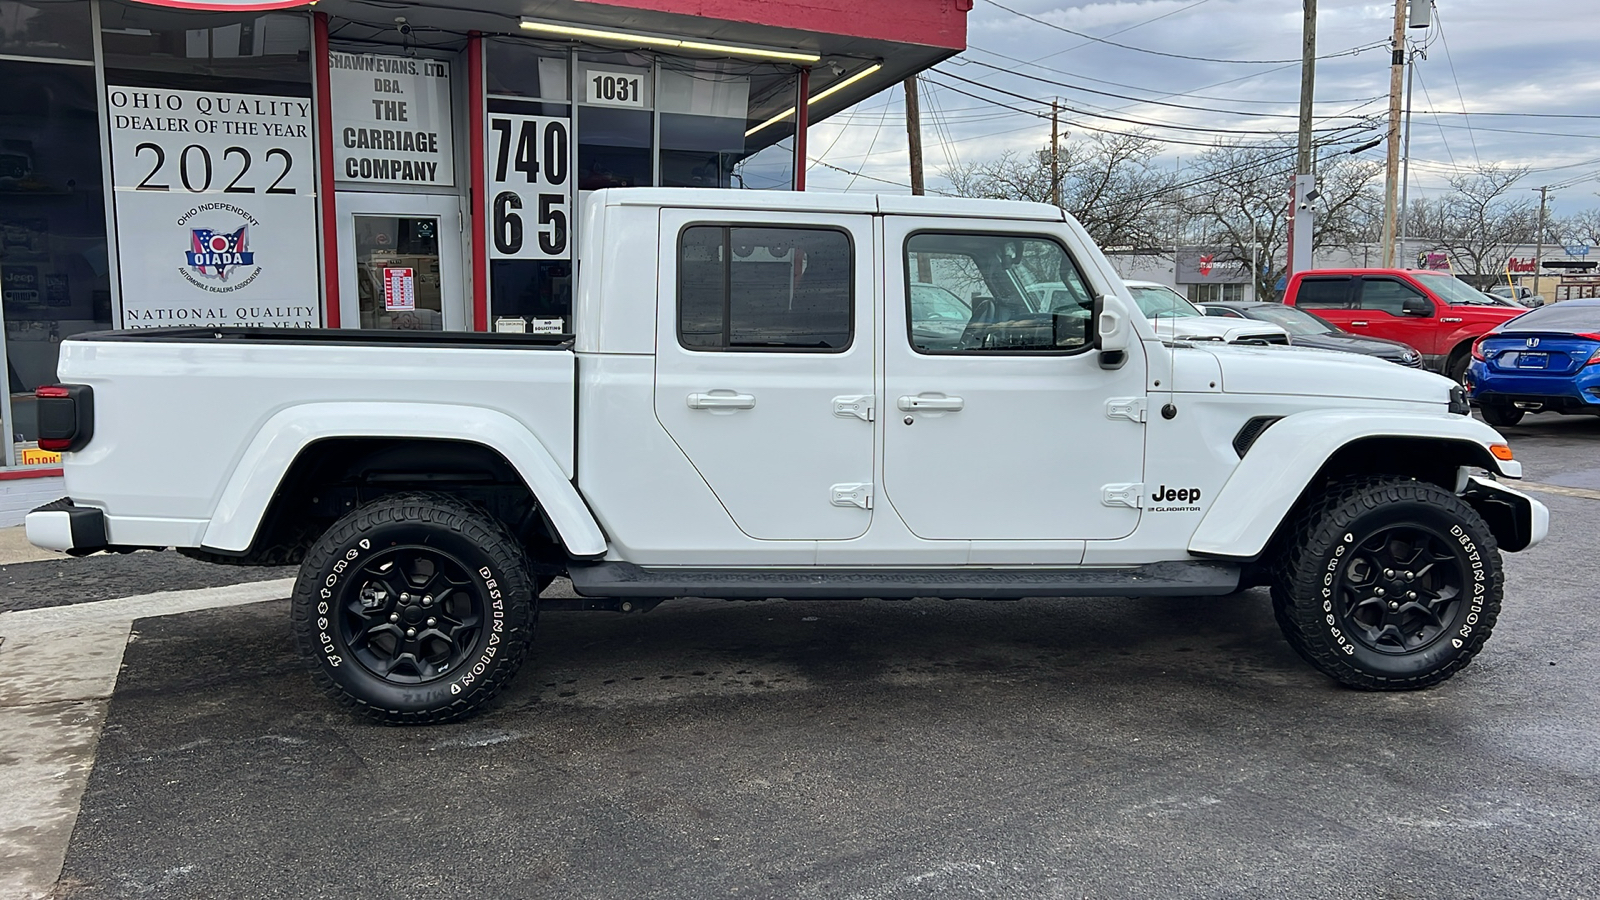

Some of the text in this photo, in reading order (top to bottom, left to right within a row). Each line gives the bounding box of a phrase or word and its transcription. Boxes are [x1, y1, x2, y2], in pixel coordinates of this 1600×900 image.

[376, 58, 419, 75] EVANS.
[424, 63, 447, 78] LTD.
[374, 79, 403, 93] DBA.
[593, 76, 638, 101] 1031
[111, 91, 309, 118] OHIO QUALITY
[372, 100, 408, 121] THE
[115, 115, 307, 137] DEALER OF THE YEAR
[343, 127, 438, 153] CARRIAGE
[491, 118, 567, 185] 740
[135, 142, 296, 194] 2022
[345, 157, 437, 181] COMPANY
[177, 202, 260, 227] OHIO INDEPENDENT
[194, 252, 243, 265] OIADA
[5, 272, 34, 283] Jeep
[178, 266, 208, 291] AUTOMOBILE
[234, 266, 262, 290] ASSOCIATION
[128, 306, 315, 320] NATIONAL QUALITY
[1152, 485, 1201, 504] Jeep
[1450, 524, 1485, 638] DESTINATION
[317, 548, 359, 667] Firestone
[1321, 545, 1355, 655] Firestone
[462, 566, 504, 687] DESTINATION
